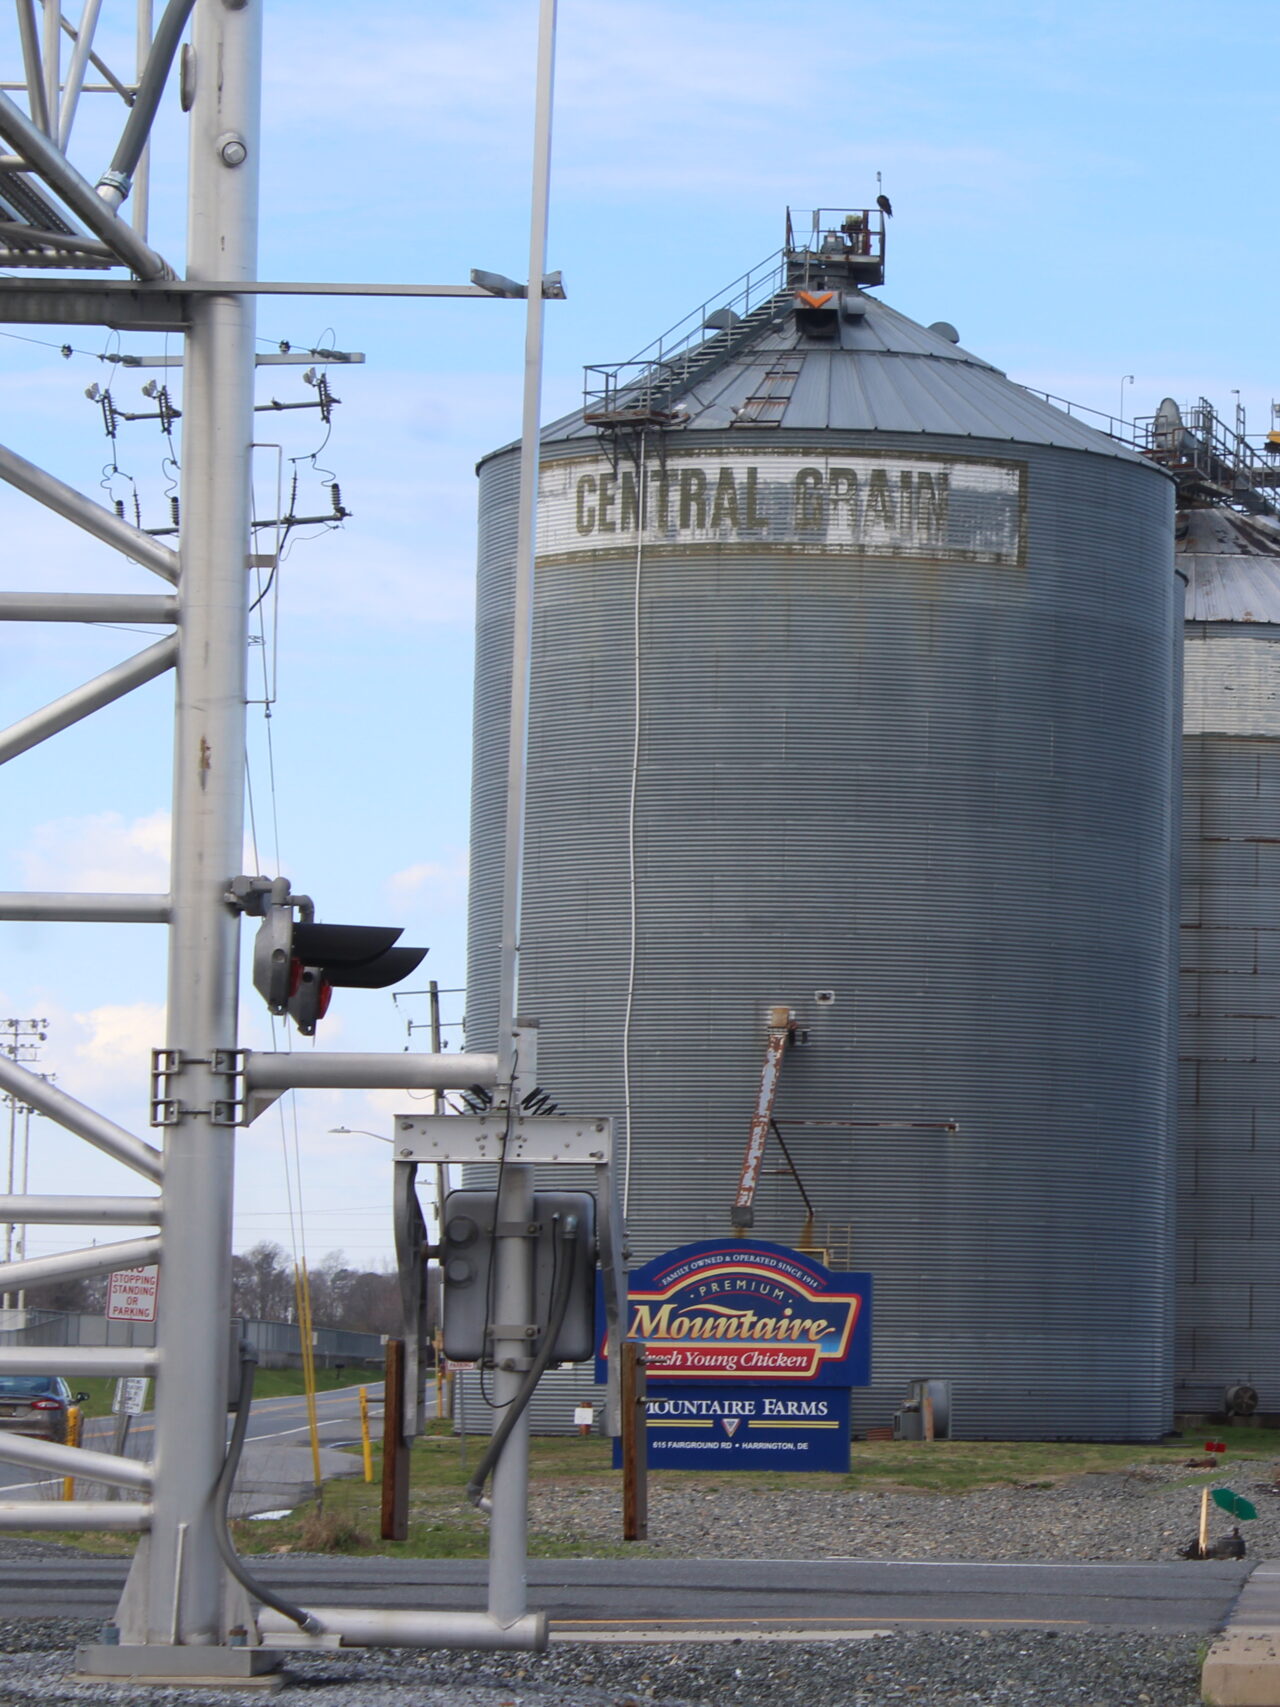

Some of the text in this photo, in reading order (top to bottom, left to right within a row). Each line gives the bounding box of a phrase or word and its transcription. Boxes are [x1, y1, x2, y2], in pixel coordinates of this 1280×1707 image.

[575, 466, 950, 536] CENTRAL GRAIN
[112, 1273, 156, 1285] STOPPING
[662, 1265, 690, 1286] FAMILY
[690, 1255, 724, 1270] OWNED
[732, 1254, 777, 1266] OPERATED
[778, 1262, 802, 1279] SINCE
[802, 1275, 819, 1288] 1914
[112, 1284, 155, 1296] STANDING
[699, 1279, 785, 1300] PREMIUM
[127, 1296, 138, 1306] OR
[112, 1306, 150, 1317] PARKING
[627, 1303, 836, 1341] Mountaire
[685, 1351, 738, 1371] Young
[740, 1351, 808, 1367] Chicken
[762, 1398, 828, 1416] FARMS
[653, 1441, 666, 1450] 615
[667, 1441, 719, 1450] FAIRGROUND
[720, 1441, 732, 1450] RD
[797, 1442, 809, 1450] DE
